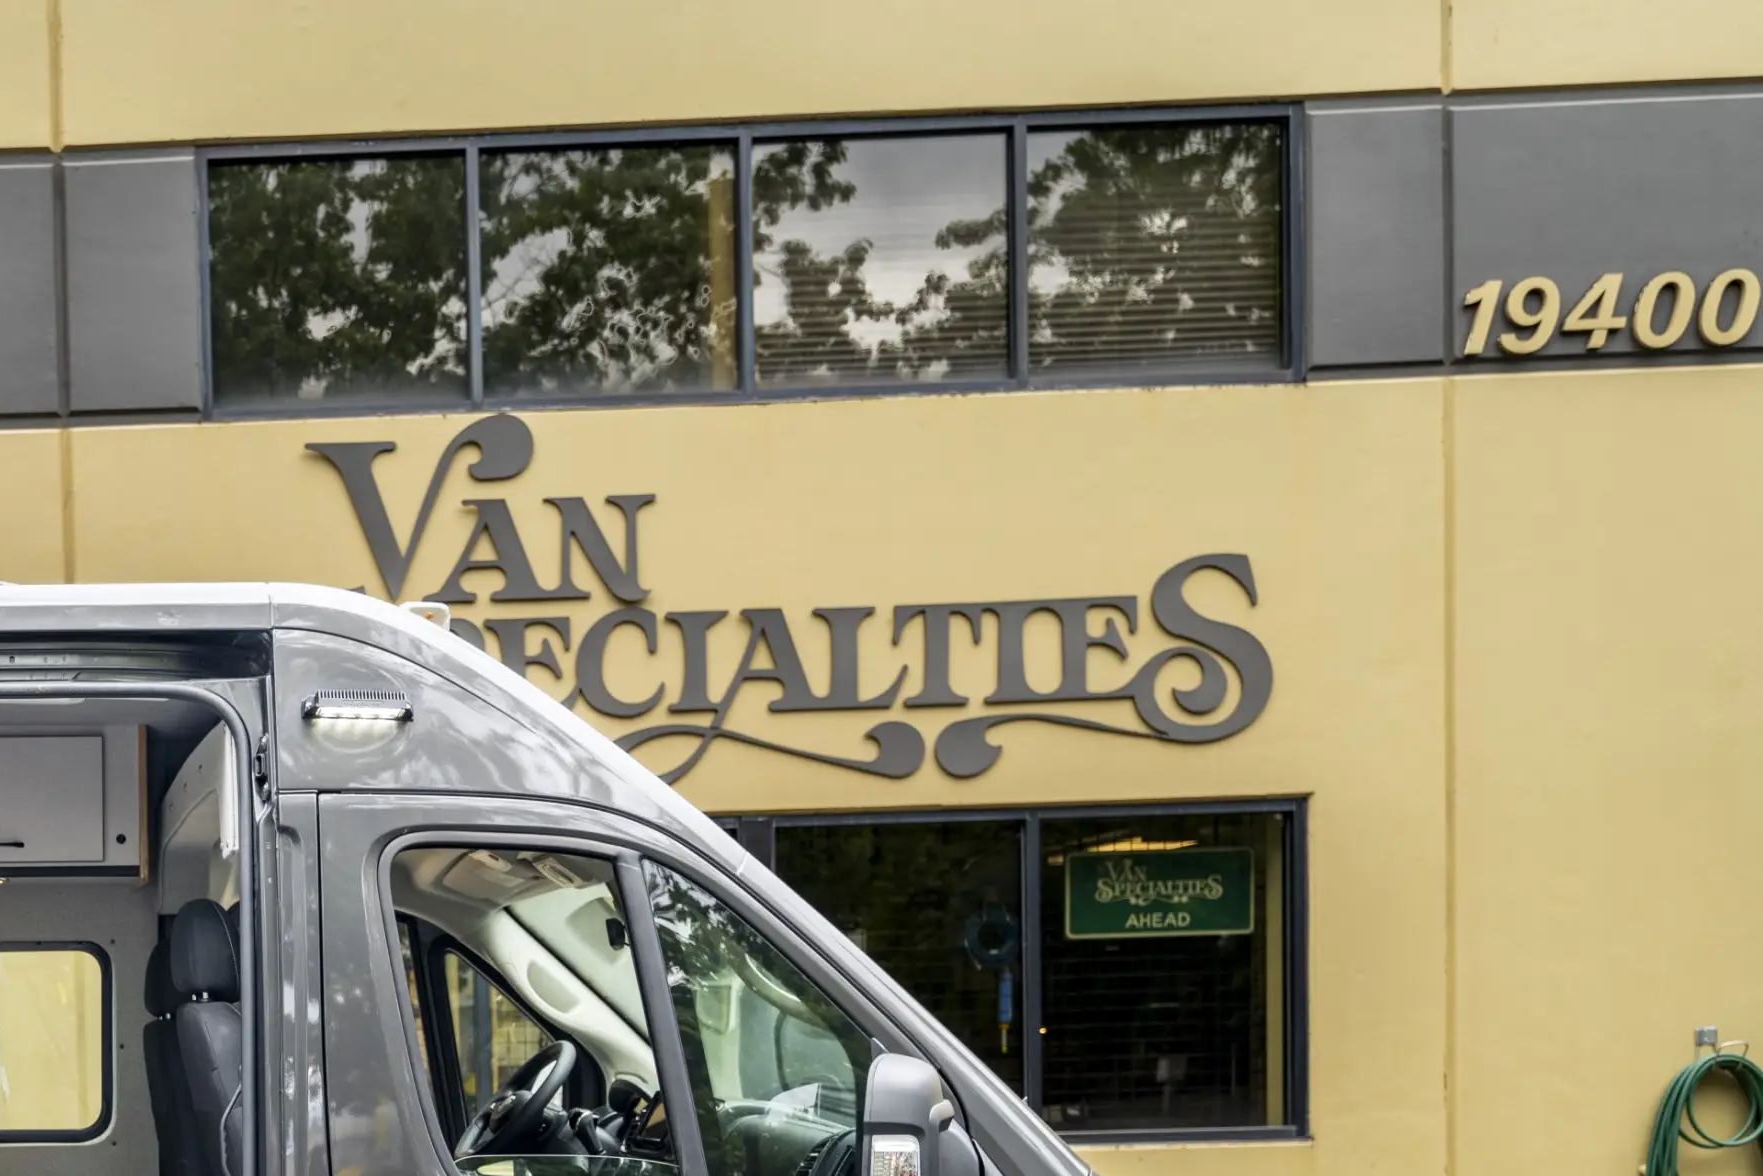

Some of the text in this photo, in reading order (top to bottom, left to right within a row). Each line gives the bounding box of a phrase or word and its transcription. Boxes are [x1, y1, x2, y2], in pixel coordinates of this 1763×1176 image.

[1463, 267, 1763, 356] 19400
[304, 413, 658, 606] VAN
[346, 552, 1274, 786] ECIALTIES
[1094, 874, 1223, 906] SPECIALTIES
[1102, 858, 1148, 881] VAN
[1125, 911, 1191, 928] AHEAD
